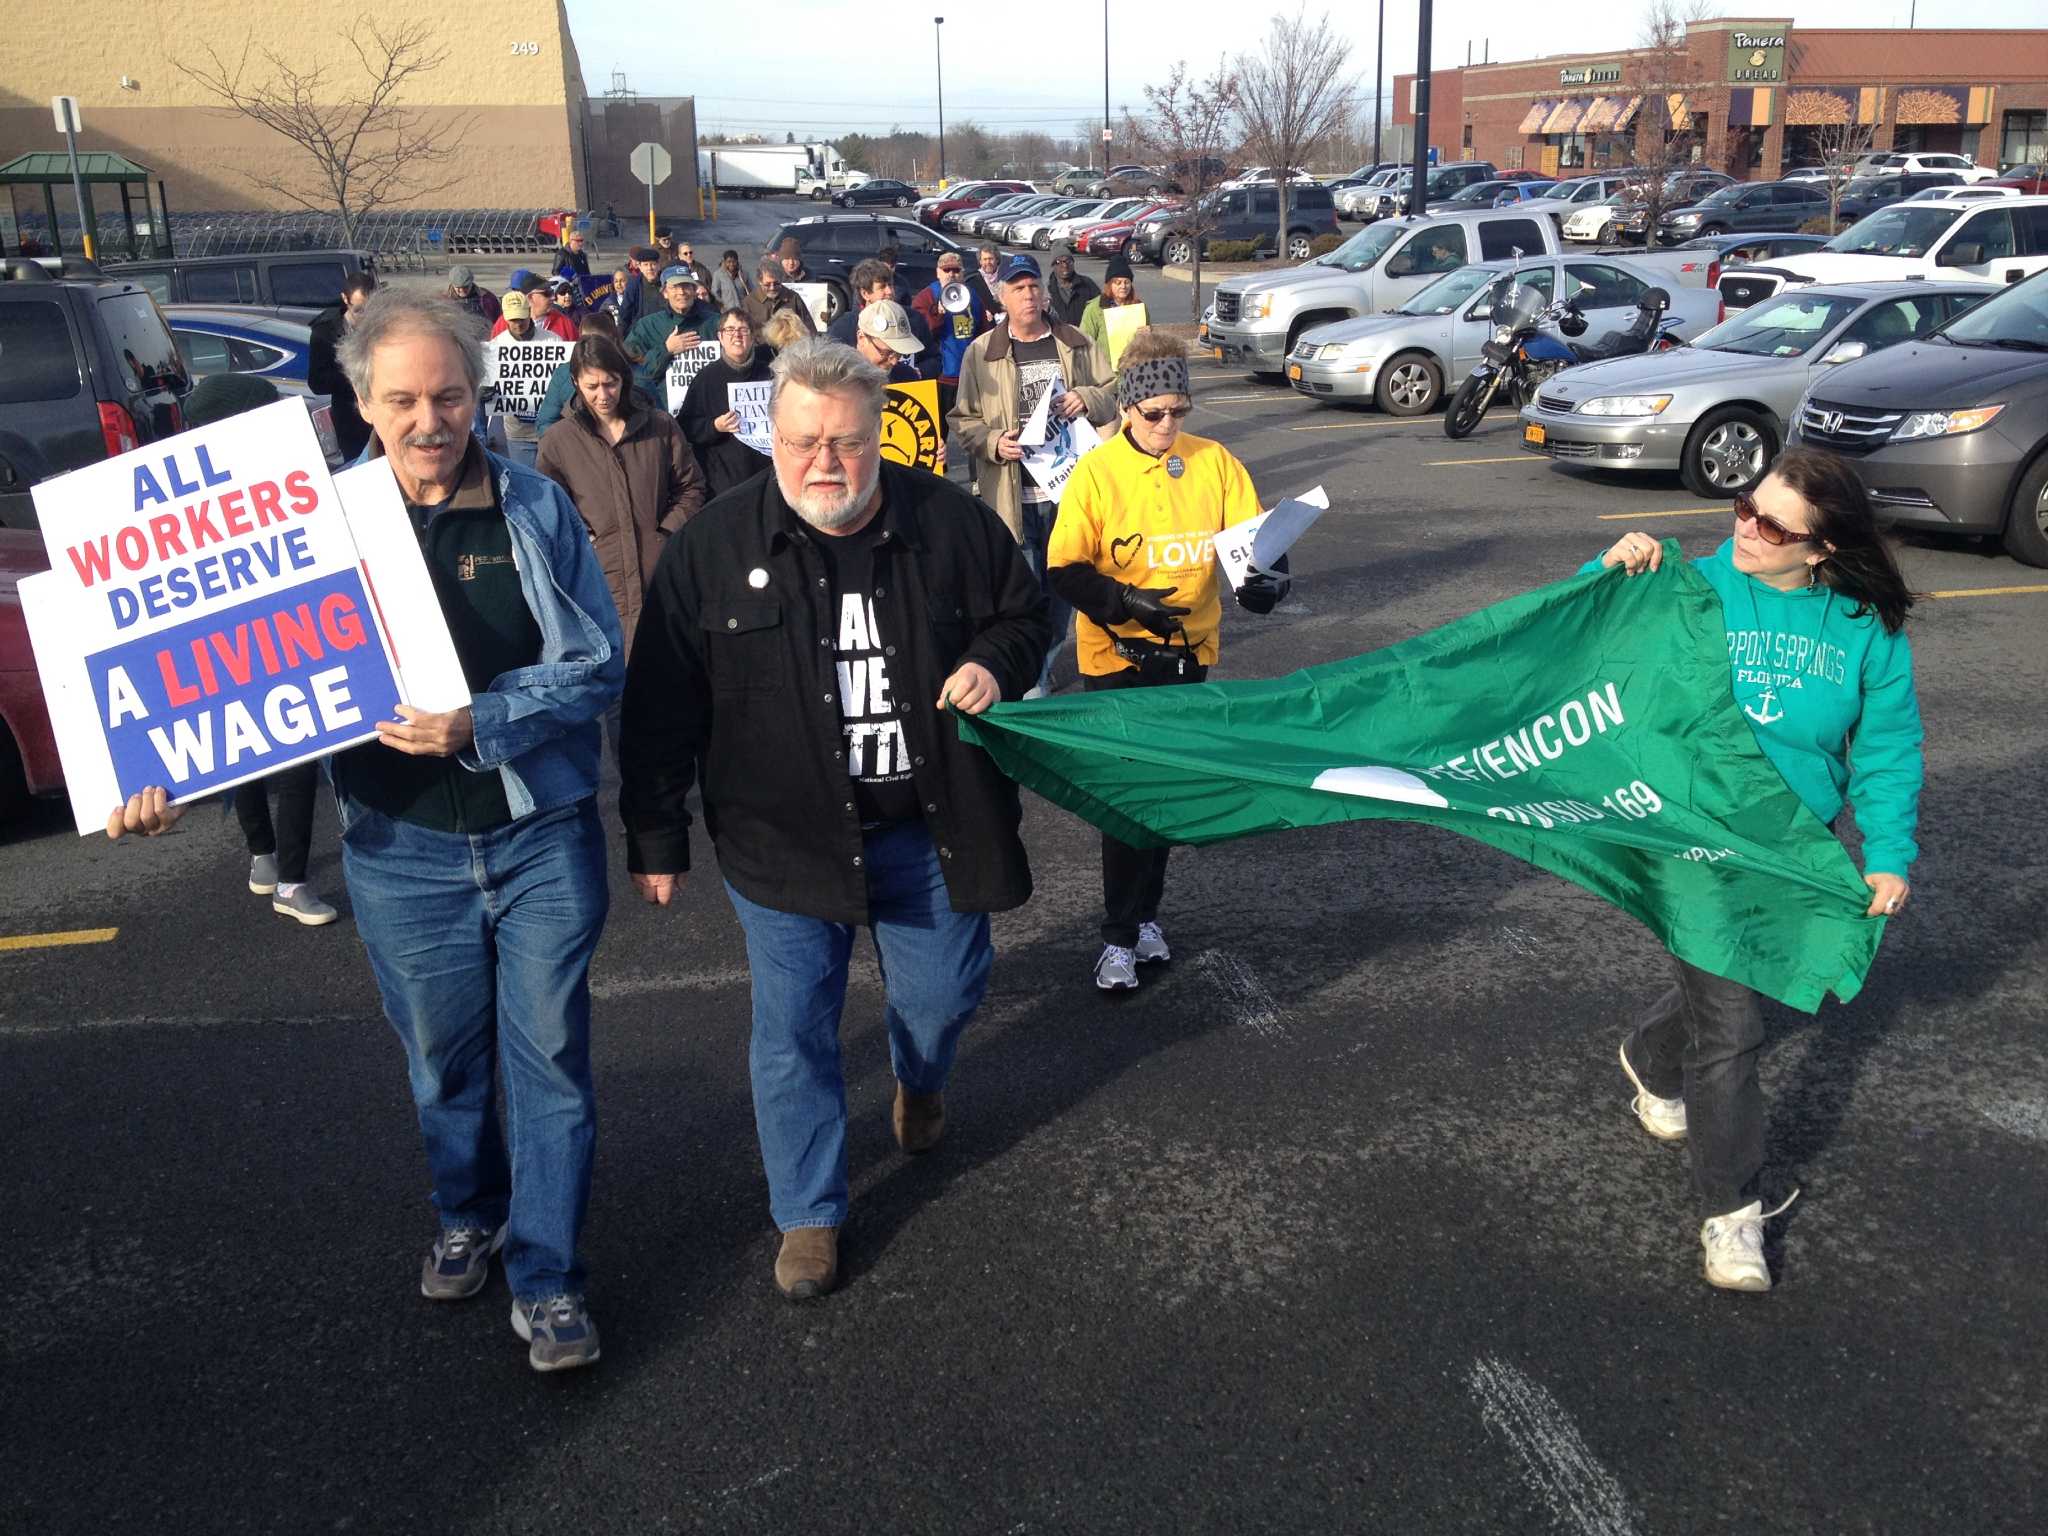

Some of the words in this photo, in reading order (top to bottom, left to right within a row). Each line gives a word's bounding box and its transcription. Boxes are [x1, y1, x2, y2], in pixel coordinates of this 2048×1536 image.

[1733, 32, 1785, 48] Panera
[511, 41, 540, 56] 249
[1736, 69, 1777, 80] BREAD
[498, 346, 566, 361] ROBBER
[673, 346, 716, 360] IVING
[500, 363, 560, 379] BARON
[494, 381, 524, 396] ARE
[734, 387, 771, 402] FAIT
[494, 398, 529, 413] AND
[734, 404, 769, 418] STAN
[882, 398, 935, 467] -MART
[134, 444, 232, 512] ALL
[67, 470, 319, 587] WORKERS
[1147, 539, 1214, 568] LOVE
[107, 527, 315, 629] DESERVE
[106, 665, 150, 729] A
[156, 592, 367, 708] LIVING
[1774, 632, 1846, 685] SPRINGS
[147, 664, 363, 784] WAGE
[1603, 780, 1662, 821] 169
